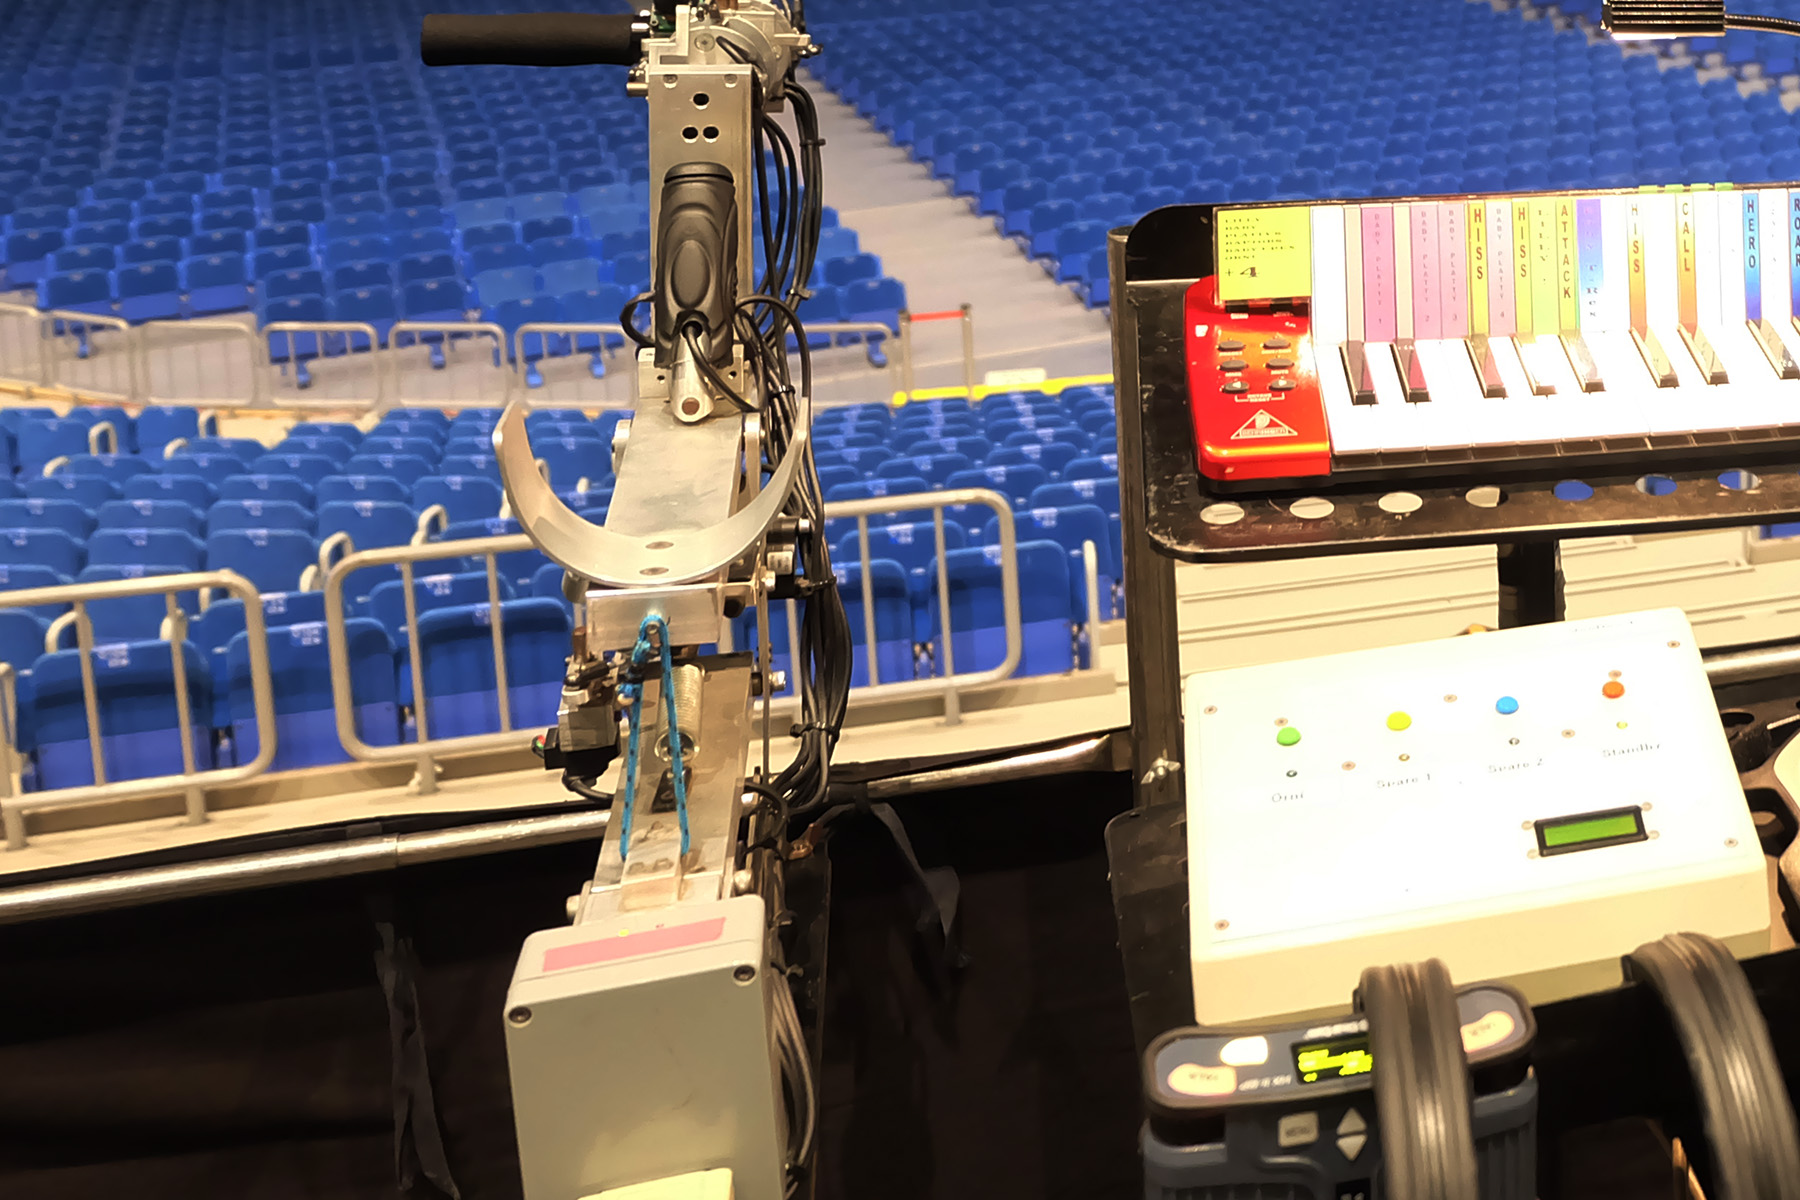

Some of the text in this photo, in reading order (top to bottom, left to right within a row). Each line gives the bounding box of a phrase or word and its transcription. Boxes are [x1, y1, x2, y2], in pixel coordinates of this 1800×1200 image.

[1473, 208, 1484, 280] HISS
[1518, 207, 1528, 278] HISS
[1561, 204, 1572, 299] ATTACK
[1631, 203, 1640, 273] HISS
[1682, 202, 1691, 272] CALL
[1747, 199, 1756, 269] HERO
